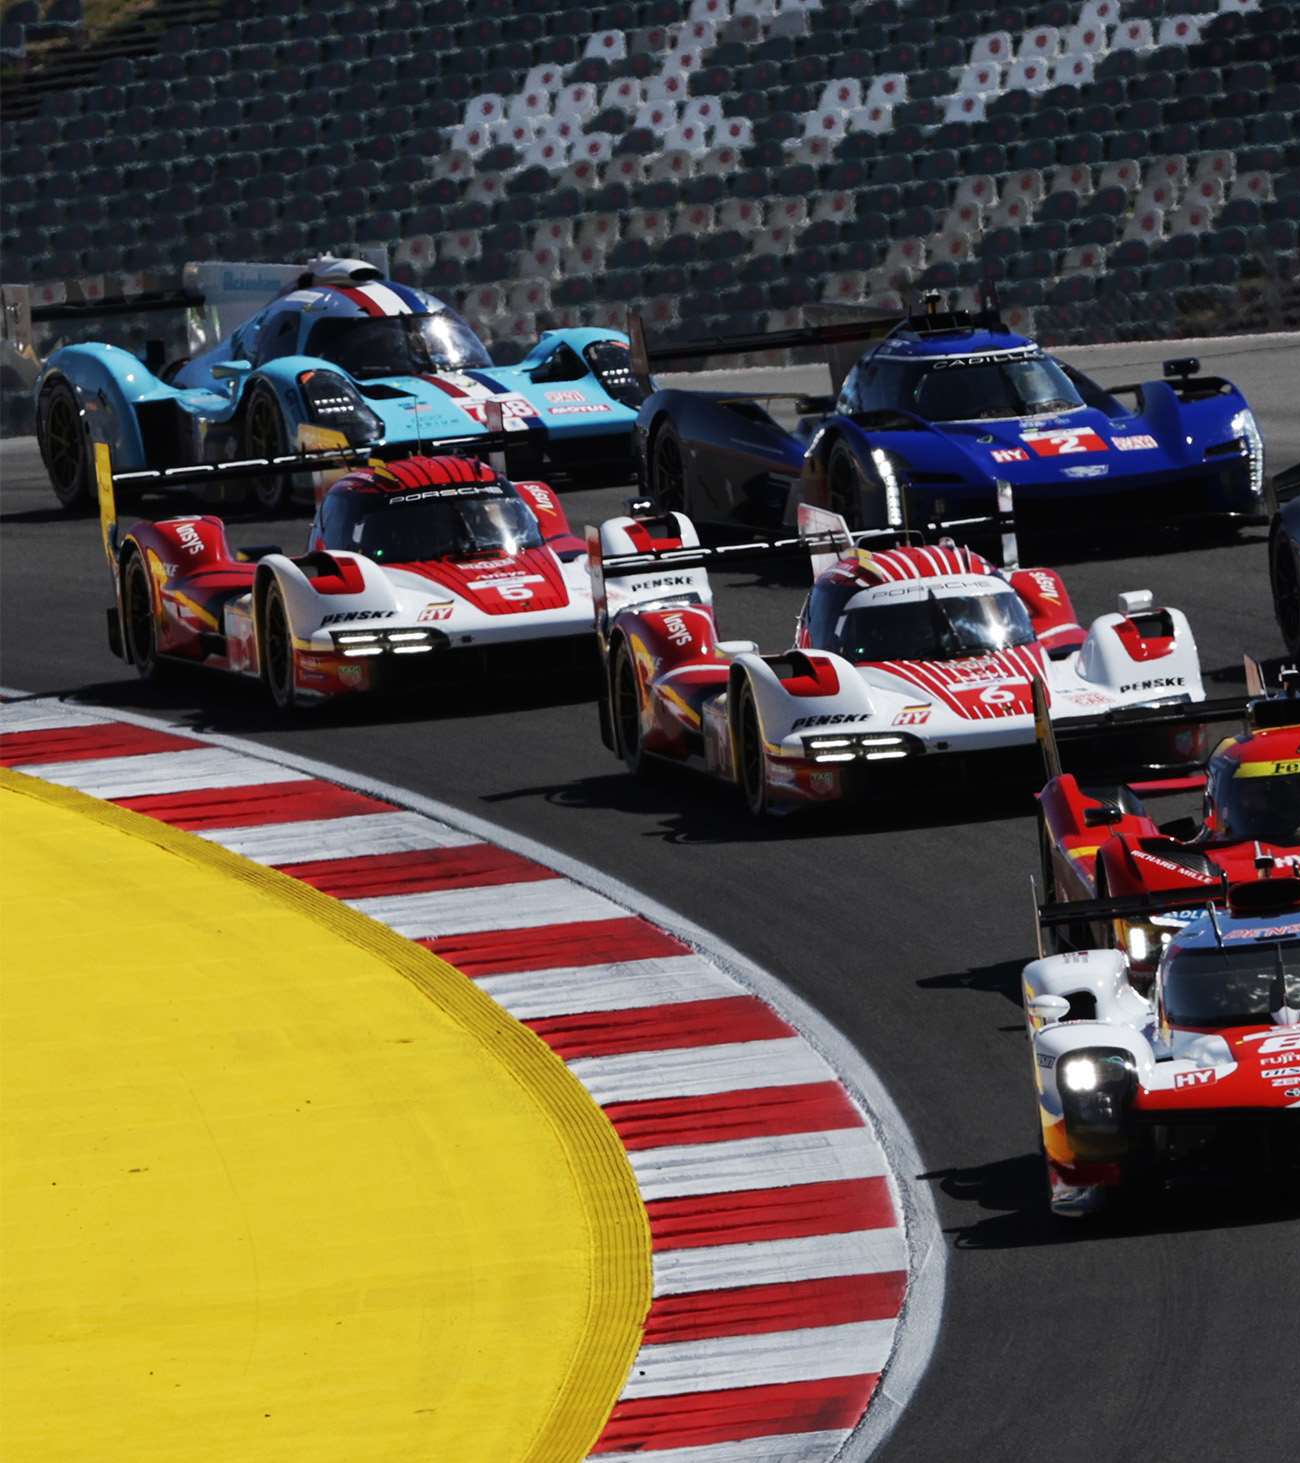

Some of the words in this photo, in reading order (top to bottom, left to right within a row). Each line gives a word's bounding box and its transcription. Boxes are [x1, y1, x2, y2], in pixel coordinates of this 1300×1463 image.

[463, 398, 535, 424] 78
[1050, 436, 1087, 454] 2
[991, 448, 1024, 464] HY
[389, 485, 503, 505] PORSCHE
[496, 583, 534, 602] 5
[631, 575, 695, 593] PENSKE
[872, 579, 992, 601] PORSCHE
[420, 608, 452, 622] HY
[1119, 676, 1186, 694] PENSKE
[979, 686, 1015, 704] 6
[791, 712, 873, 731] PENSKE
[894, 711, 930, 726] HY
[1176, 1069, 1214, 1088] HY
